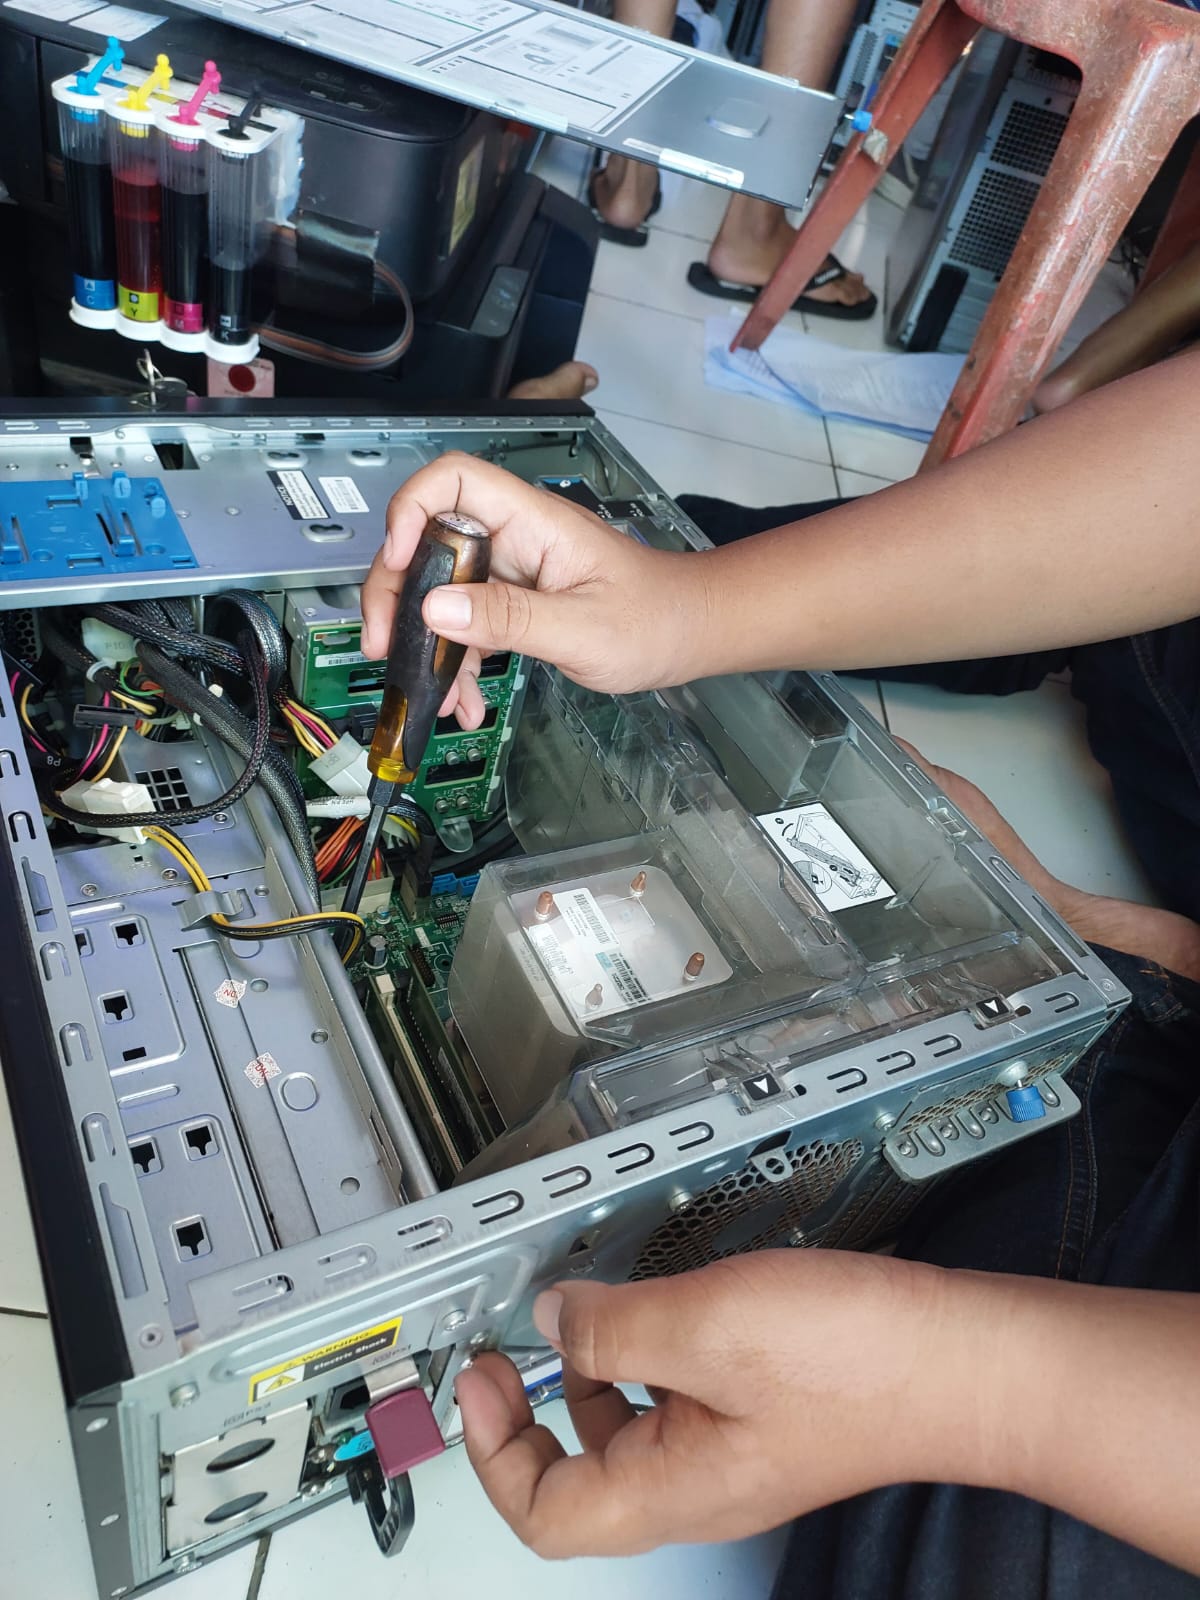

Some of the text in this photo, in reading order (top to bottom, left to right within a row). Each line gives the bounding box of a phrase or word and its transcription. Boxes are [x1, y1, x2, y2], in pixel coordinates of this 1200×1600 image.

[87, 295, 95, 305] C
[131, 308, 137, 317] Y
[175, 319, 184, 329] M
[221, 331, 229, 341] K
[47, 755, 62, 767] P8
[355, 1337, 387, 1356] Shock
